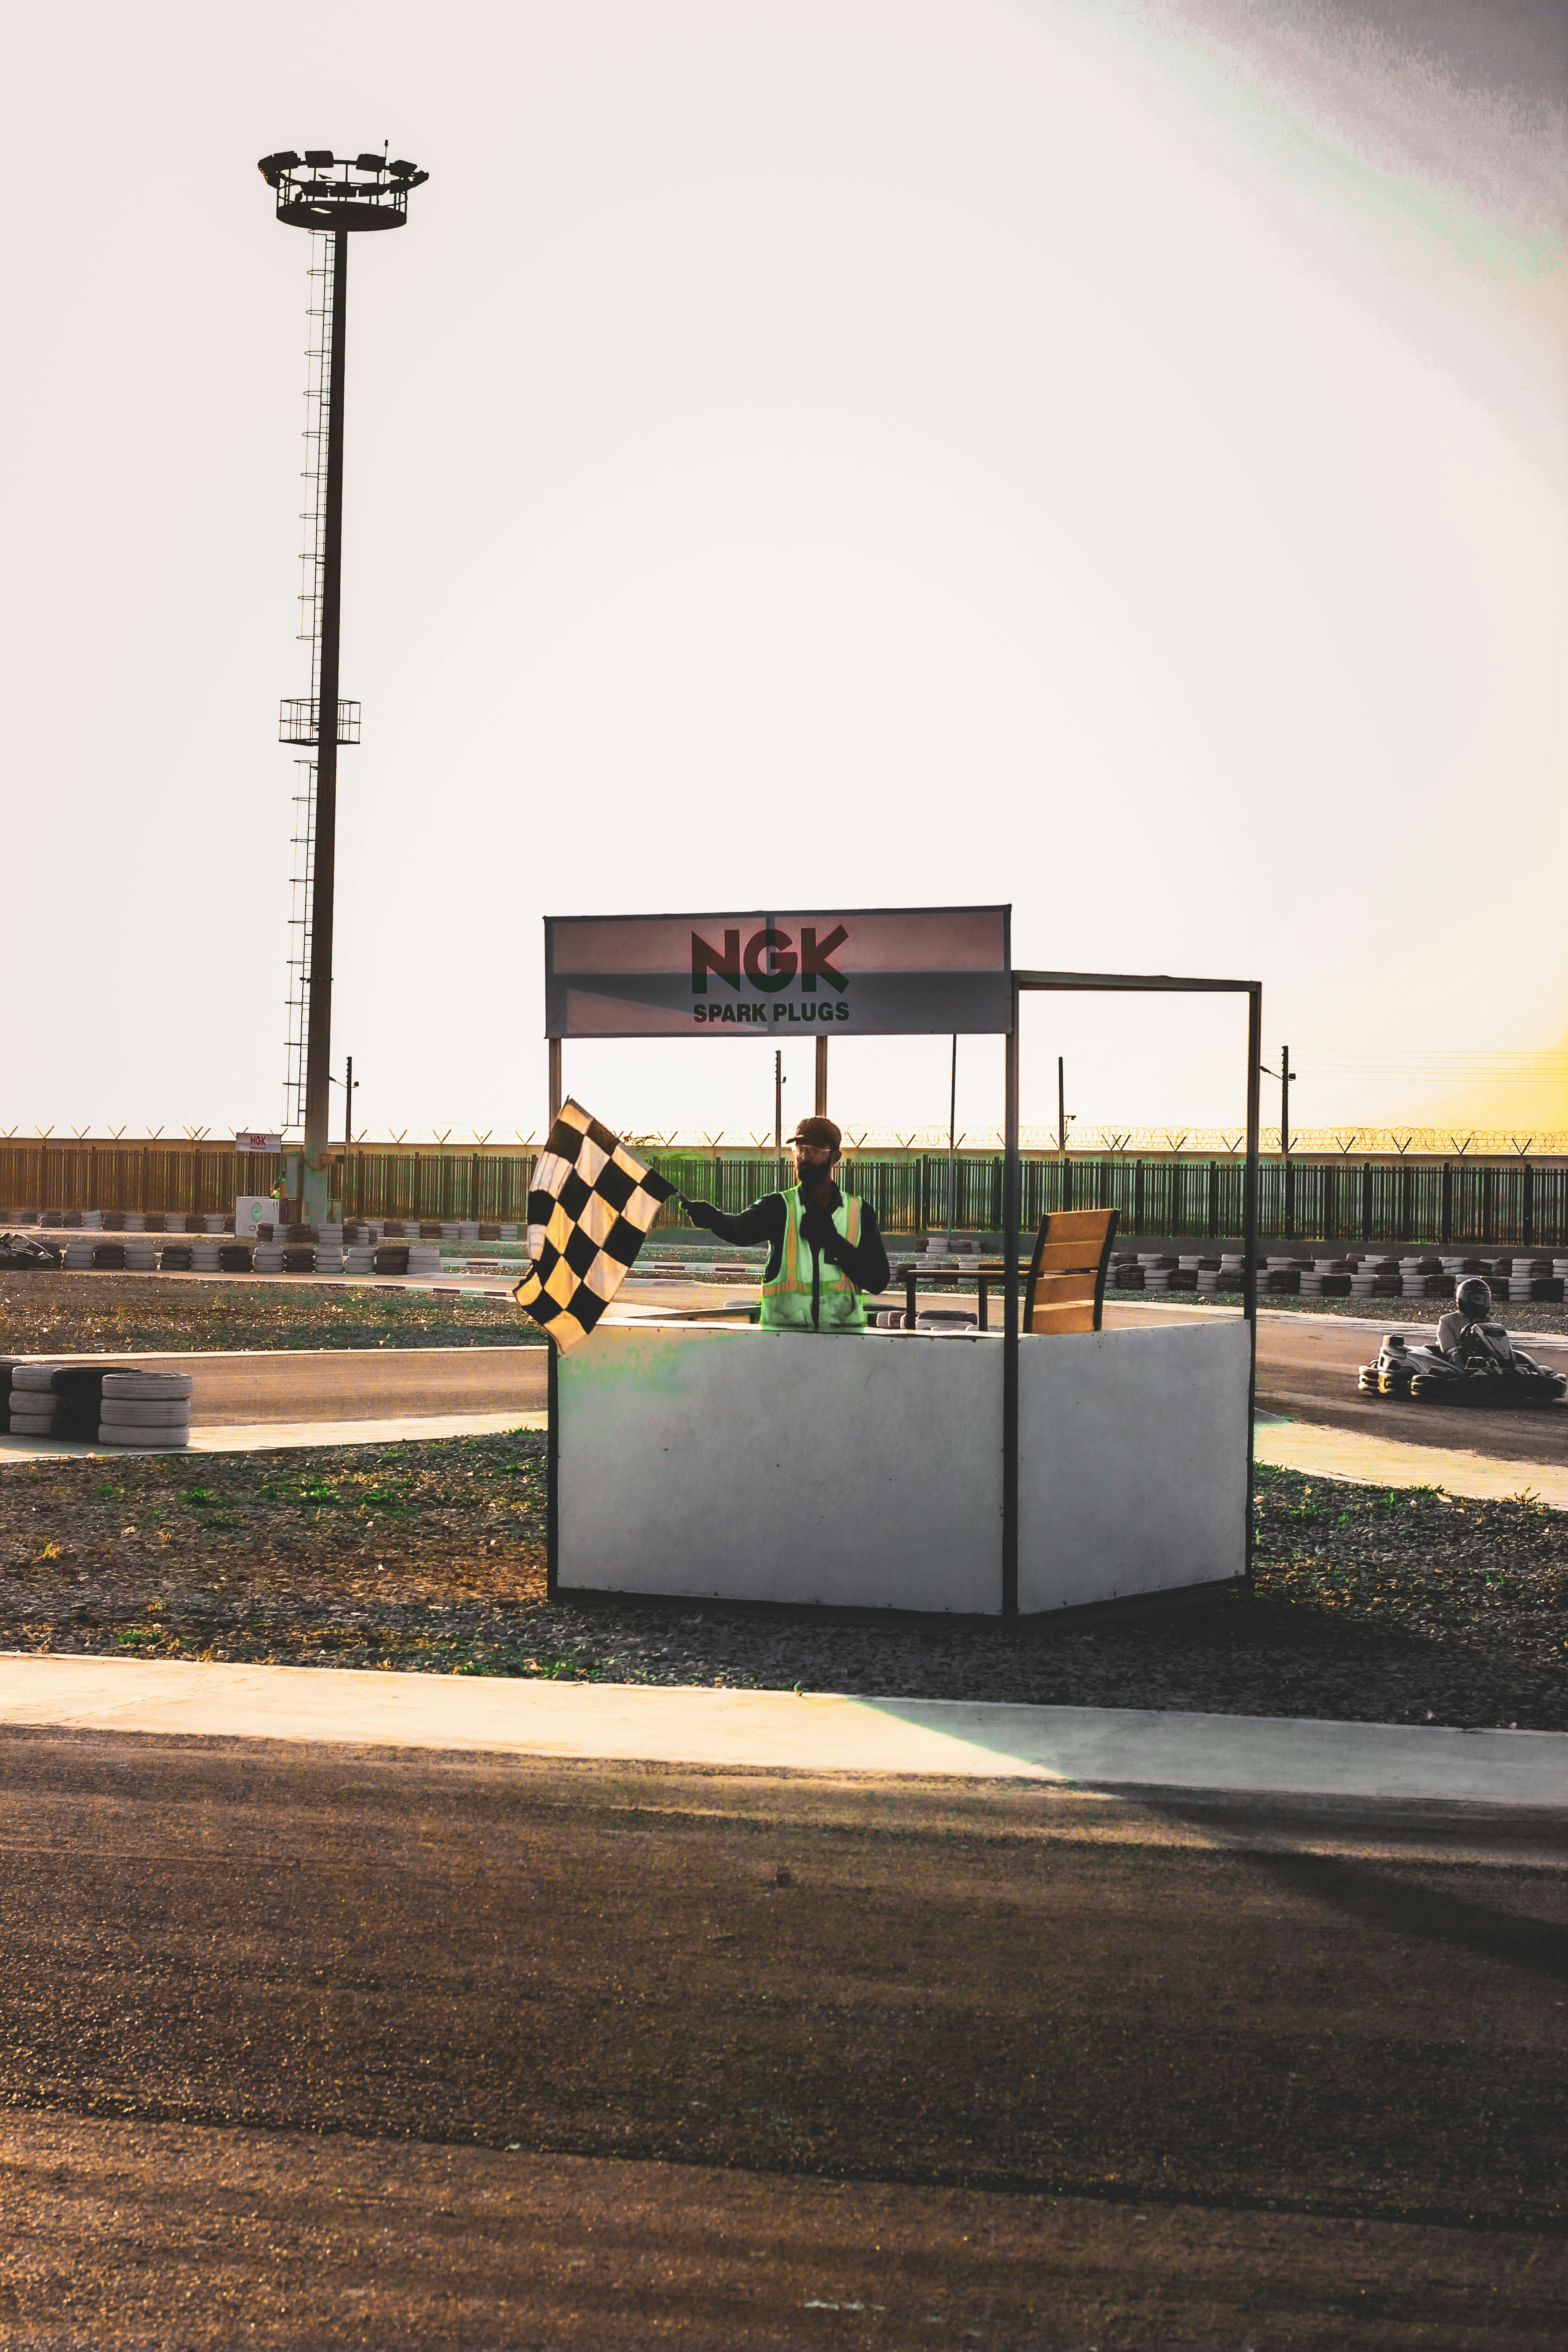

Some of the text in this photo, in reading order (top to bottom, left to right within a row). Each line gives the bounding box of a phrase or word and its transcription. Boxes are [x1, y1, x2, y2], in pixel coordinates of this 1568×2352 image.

[691, 924, 849, 994] NGK
[693, 1002, 850, 1023] SPARK PLUGS
[250, 1135, 266, 1146] NGK
[273, 1200, 279, 1212] 11
